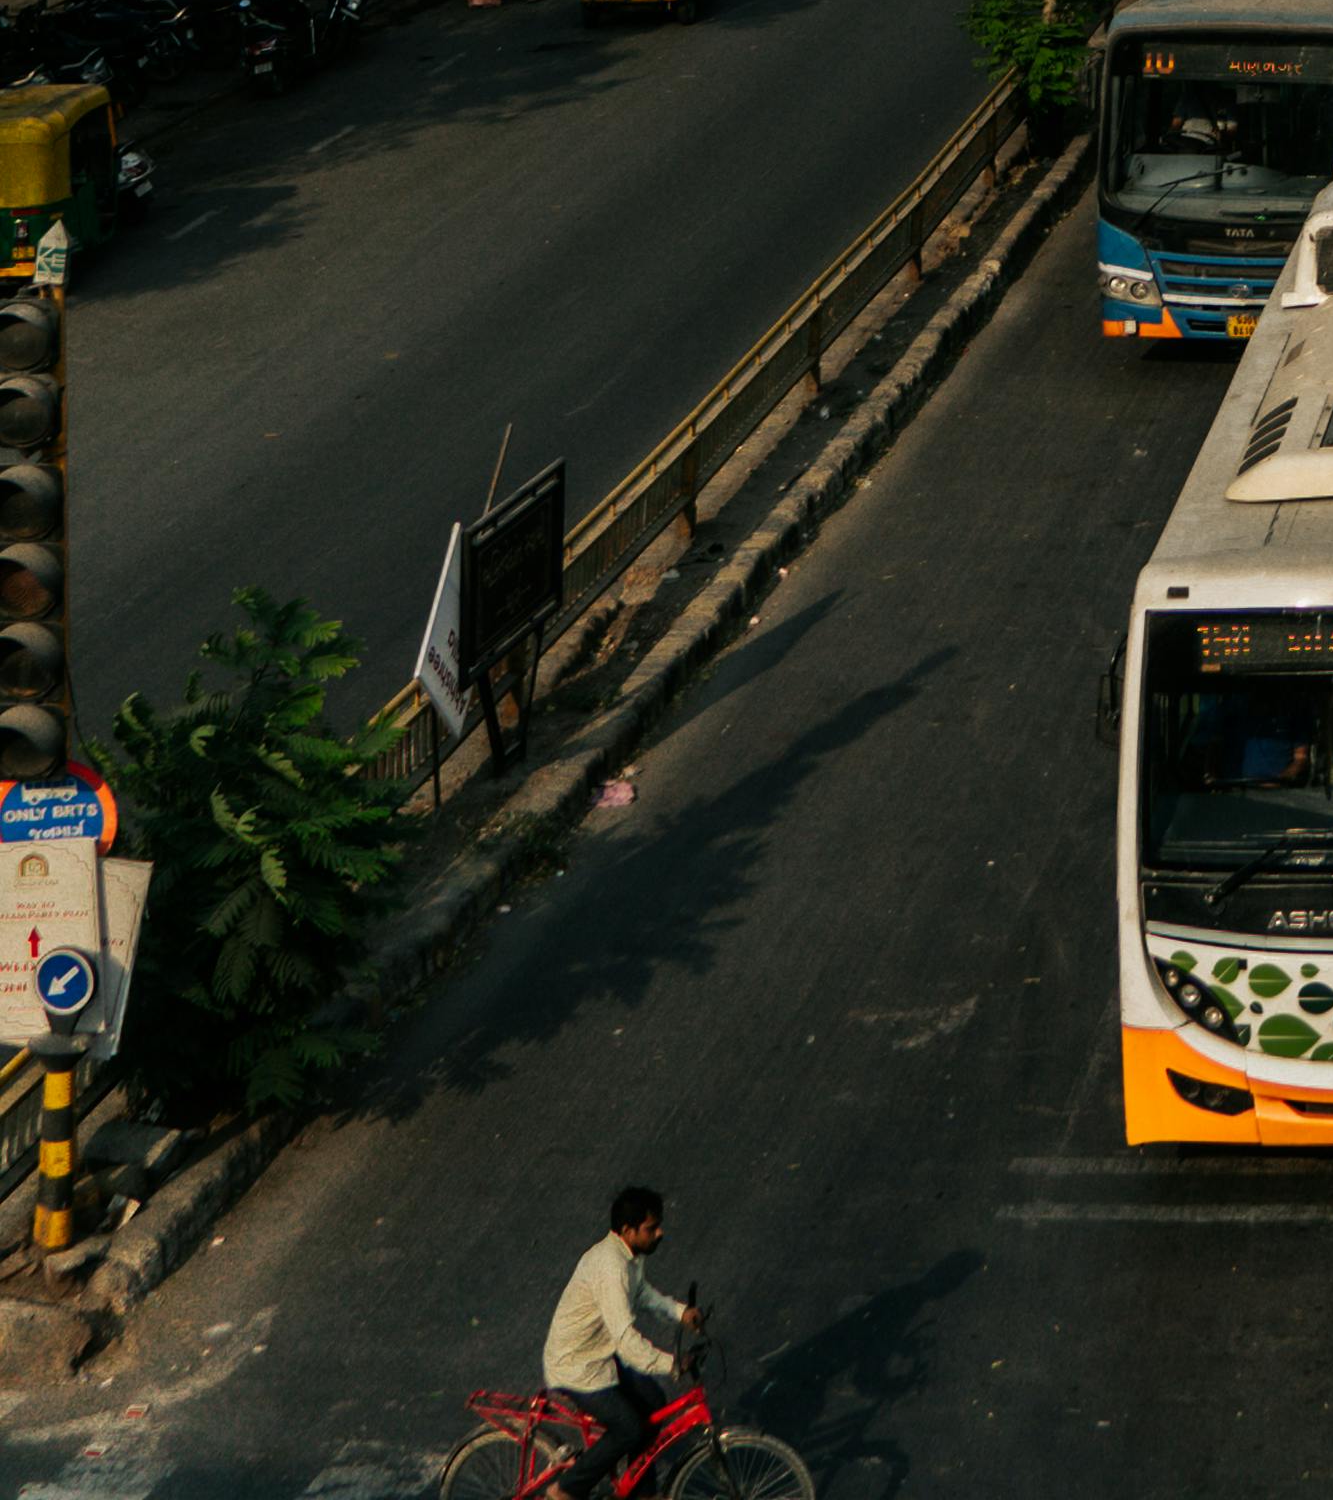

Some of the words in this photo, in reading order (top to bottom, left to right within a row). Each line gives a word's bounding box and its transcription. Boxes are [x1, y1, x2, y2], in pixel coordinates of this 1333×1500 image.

[1224, 228, 1255, 238] TATA
[3, 806, 47, 823] ONLY
[52, 803, 98, 819] BRTS
